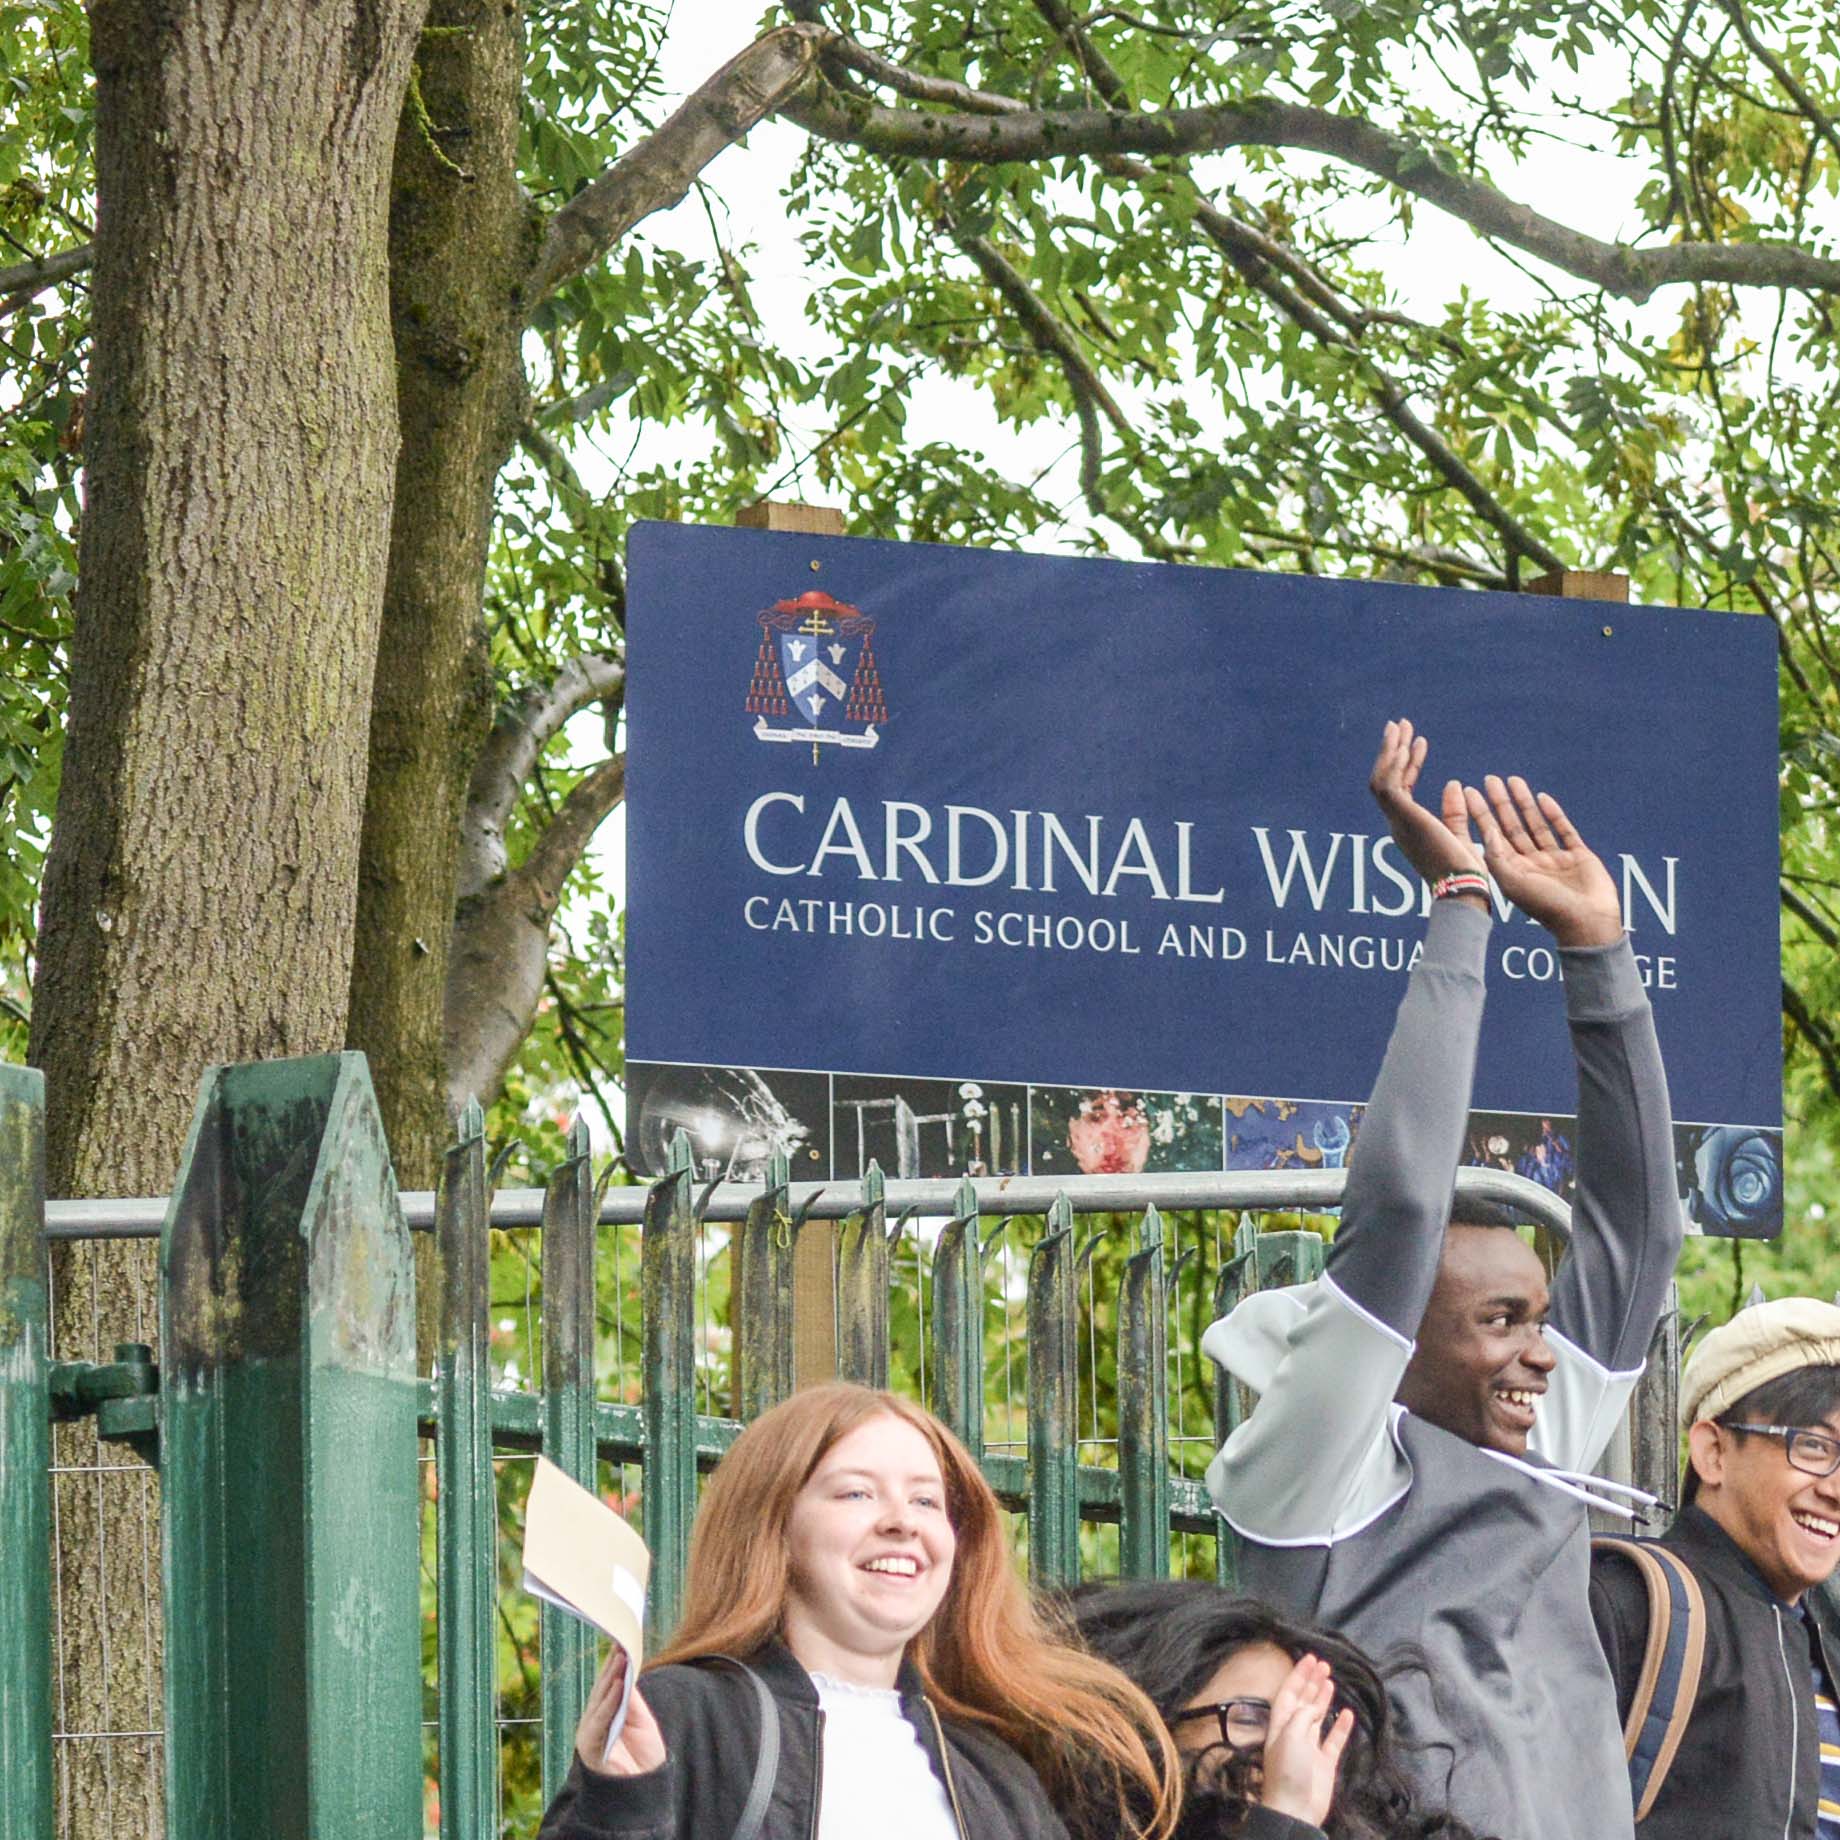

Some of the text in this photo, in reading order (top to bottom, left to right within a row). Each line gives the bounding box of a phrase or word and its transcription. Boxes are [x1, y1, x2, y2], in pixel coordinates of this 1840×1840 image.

[743, 791, 1680, 936] CARDINAL WISN
[743, 896, 1678, 990] CATHOLIC SCHOOL AND LANGUA COGE
